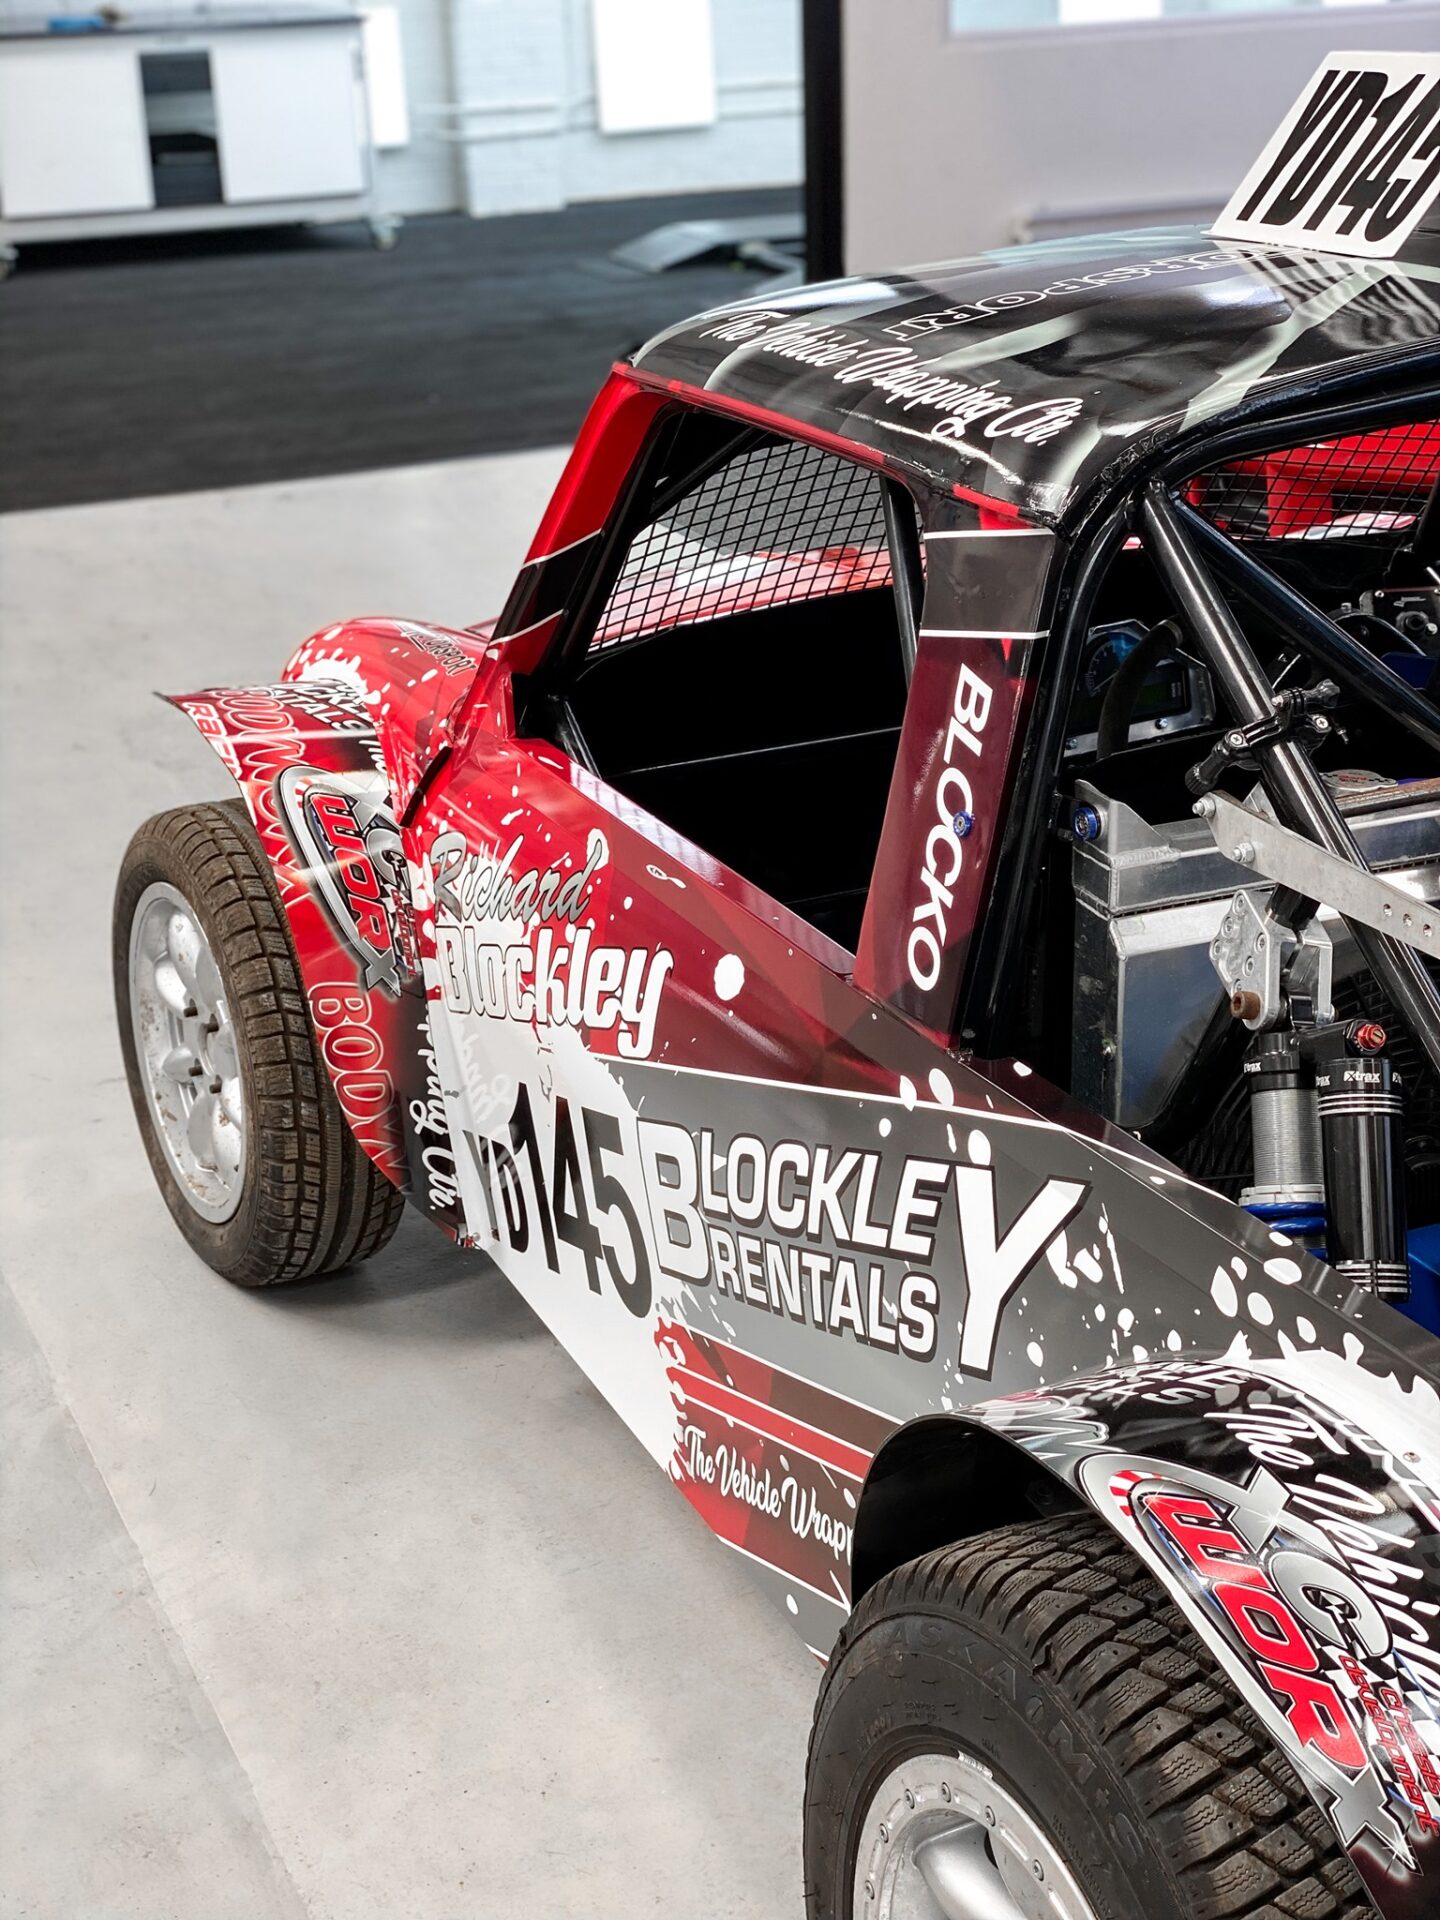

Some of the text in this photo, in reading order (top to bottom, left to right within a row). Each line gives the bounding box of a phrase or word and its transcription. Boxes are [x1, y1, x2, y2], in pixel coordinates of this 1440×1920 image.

[1236, 70, 1440, 242] YD145
[699, 310, 790, 344] The
[737, 322, 869, 369] Vehicle
[833, 347, 1013, 438] Wrapping
[430, 831, 602, 923] Richard
[907, 663, 993, 991] BLOCKO
[435, 925, 674, 1060] Blockley
[462, 1082, 652, 1318] YD145
[637, 1117, 1093, 1381] BLOCKLEY
[708, 1223, 940, 1362] RENTALS
[684, 1425, 716, 1484] The
[714, 1444, 783, 1518] Vehicle
[1203, 1402, 1350, 1470] The
[1140, 1492, 1424, 1876] WORX
